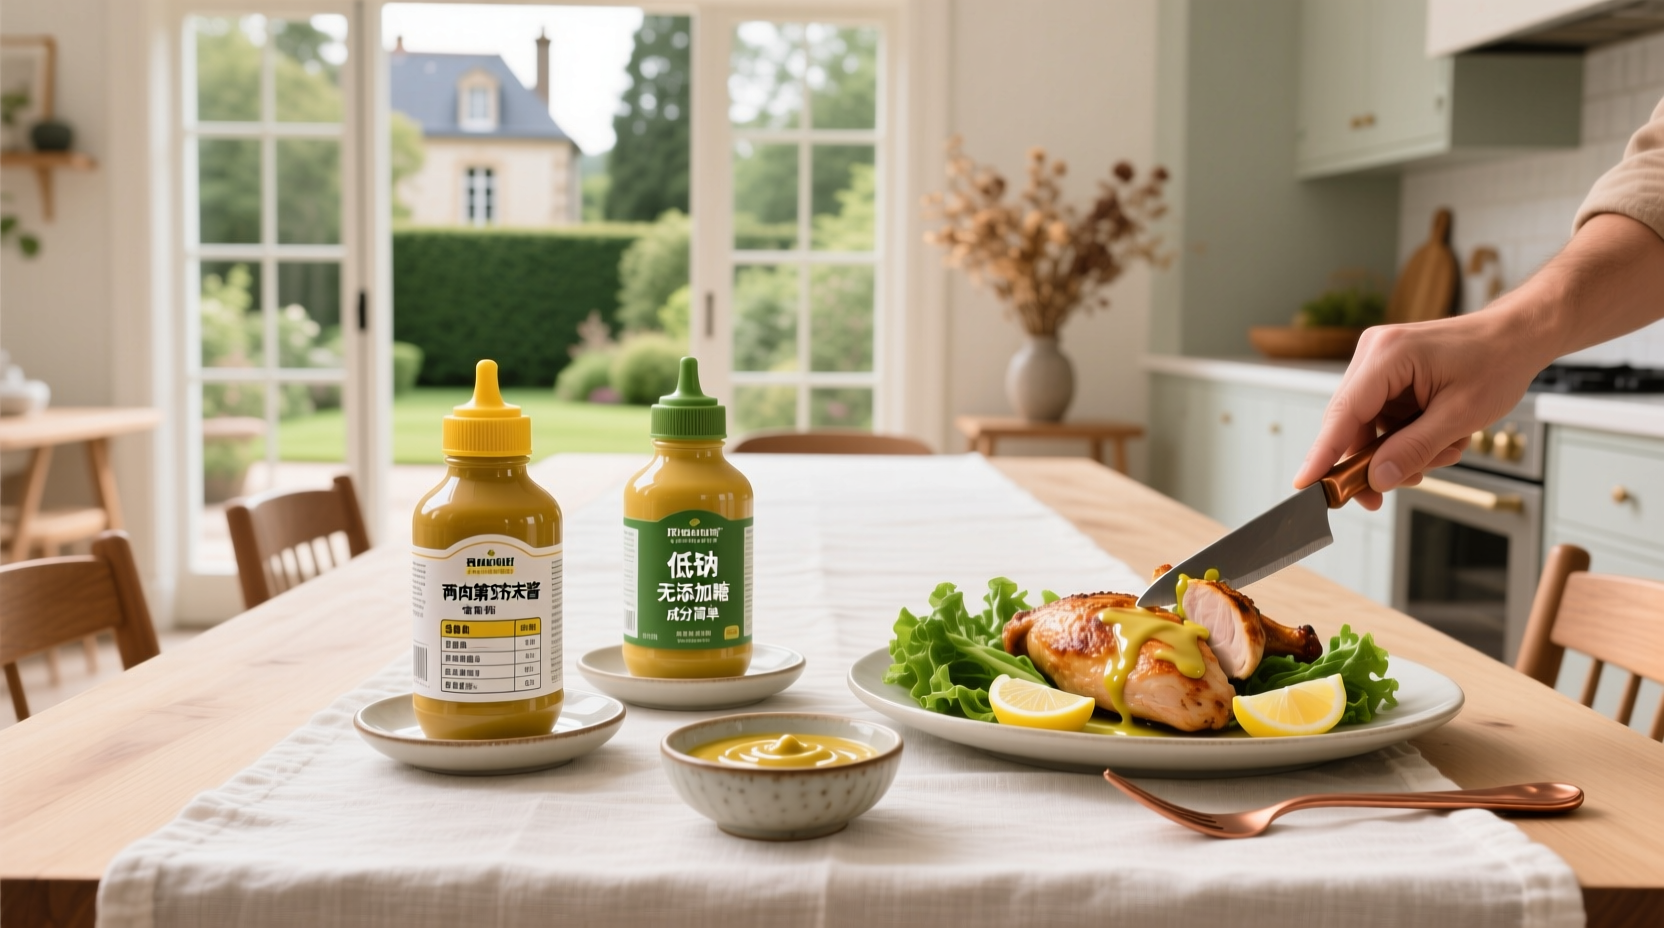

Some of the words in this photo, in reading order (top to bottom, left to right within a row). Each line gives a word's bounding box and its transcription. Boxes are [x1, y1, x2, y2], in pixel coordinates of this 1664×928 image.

[667, 550, 719, 579] 低钠
[657, 581, 730, 603] 无添加糖
[666, 604, 720, 622] 成分简单
